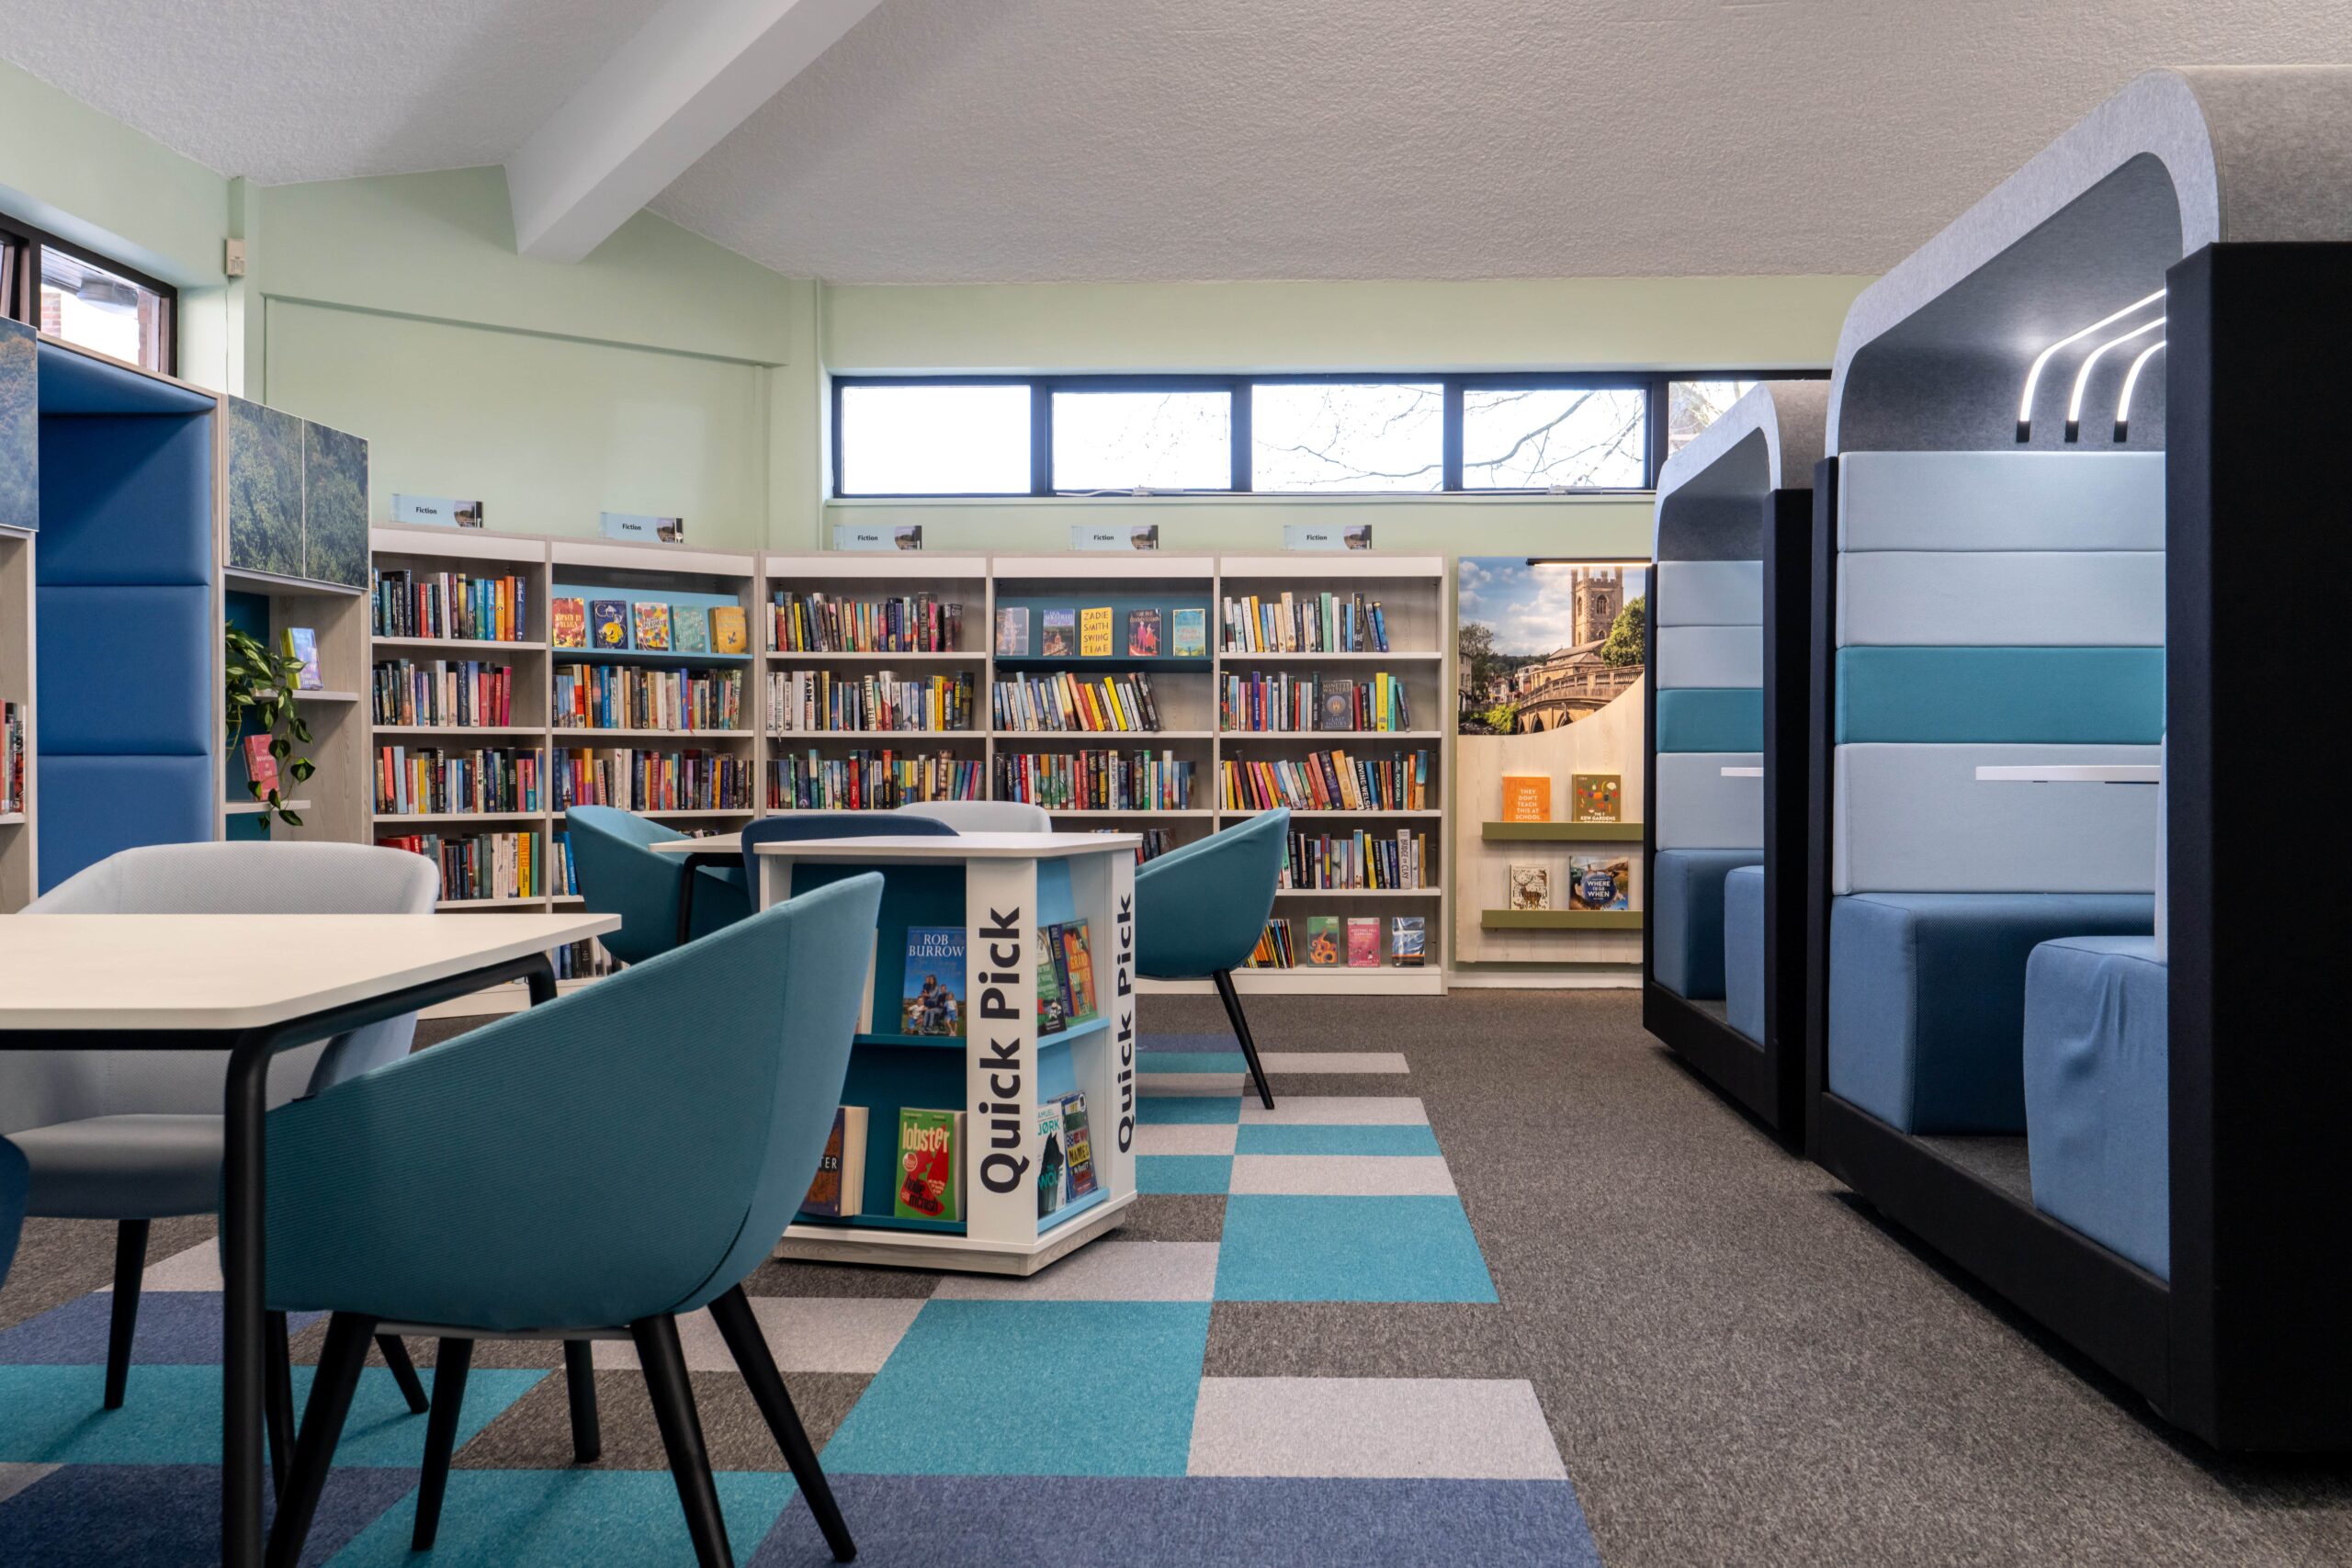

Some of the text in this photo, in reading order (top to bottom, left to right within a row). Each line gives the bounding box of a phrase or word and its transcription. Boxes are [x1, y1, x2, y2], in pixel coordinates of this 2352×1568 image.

[415, 506, 437, 514] Fiction
[622, 523, 641, 531] Fiction
[1083, 611, 1108, 620] ZADIE
[1083, 623, 1109, 631] SMITH
[1083, 634, 1108, 642] SWING
[1083, 645, 1108, 653] TIME
[1357, 761, 1371, 810] IRVINE WELSH
[520, 836, 530, 867] HUNTED
[1401, 839, 1409, 858] BRIDGE
[1401, 864, 1409, 879] CLAY
[923, 933, 948, 945] ROB
[909, 945, 965, 957] BURROW
[1116, 893, 1135, 1154] Quick Pick
[978, 907, 1030, 1193] Quick Pick
[1037, 1109, 1054, 1118] AMUEL
[1037, 1119, 1060, 1135] JØRK
[902, 1122, 950, 1153] lobster
[1069, 1144, 1090, 1166] NAMES
